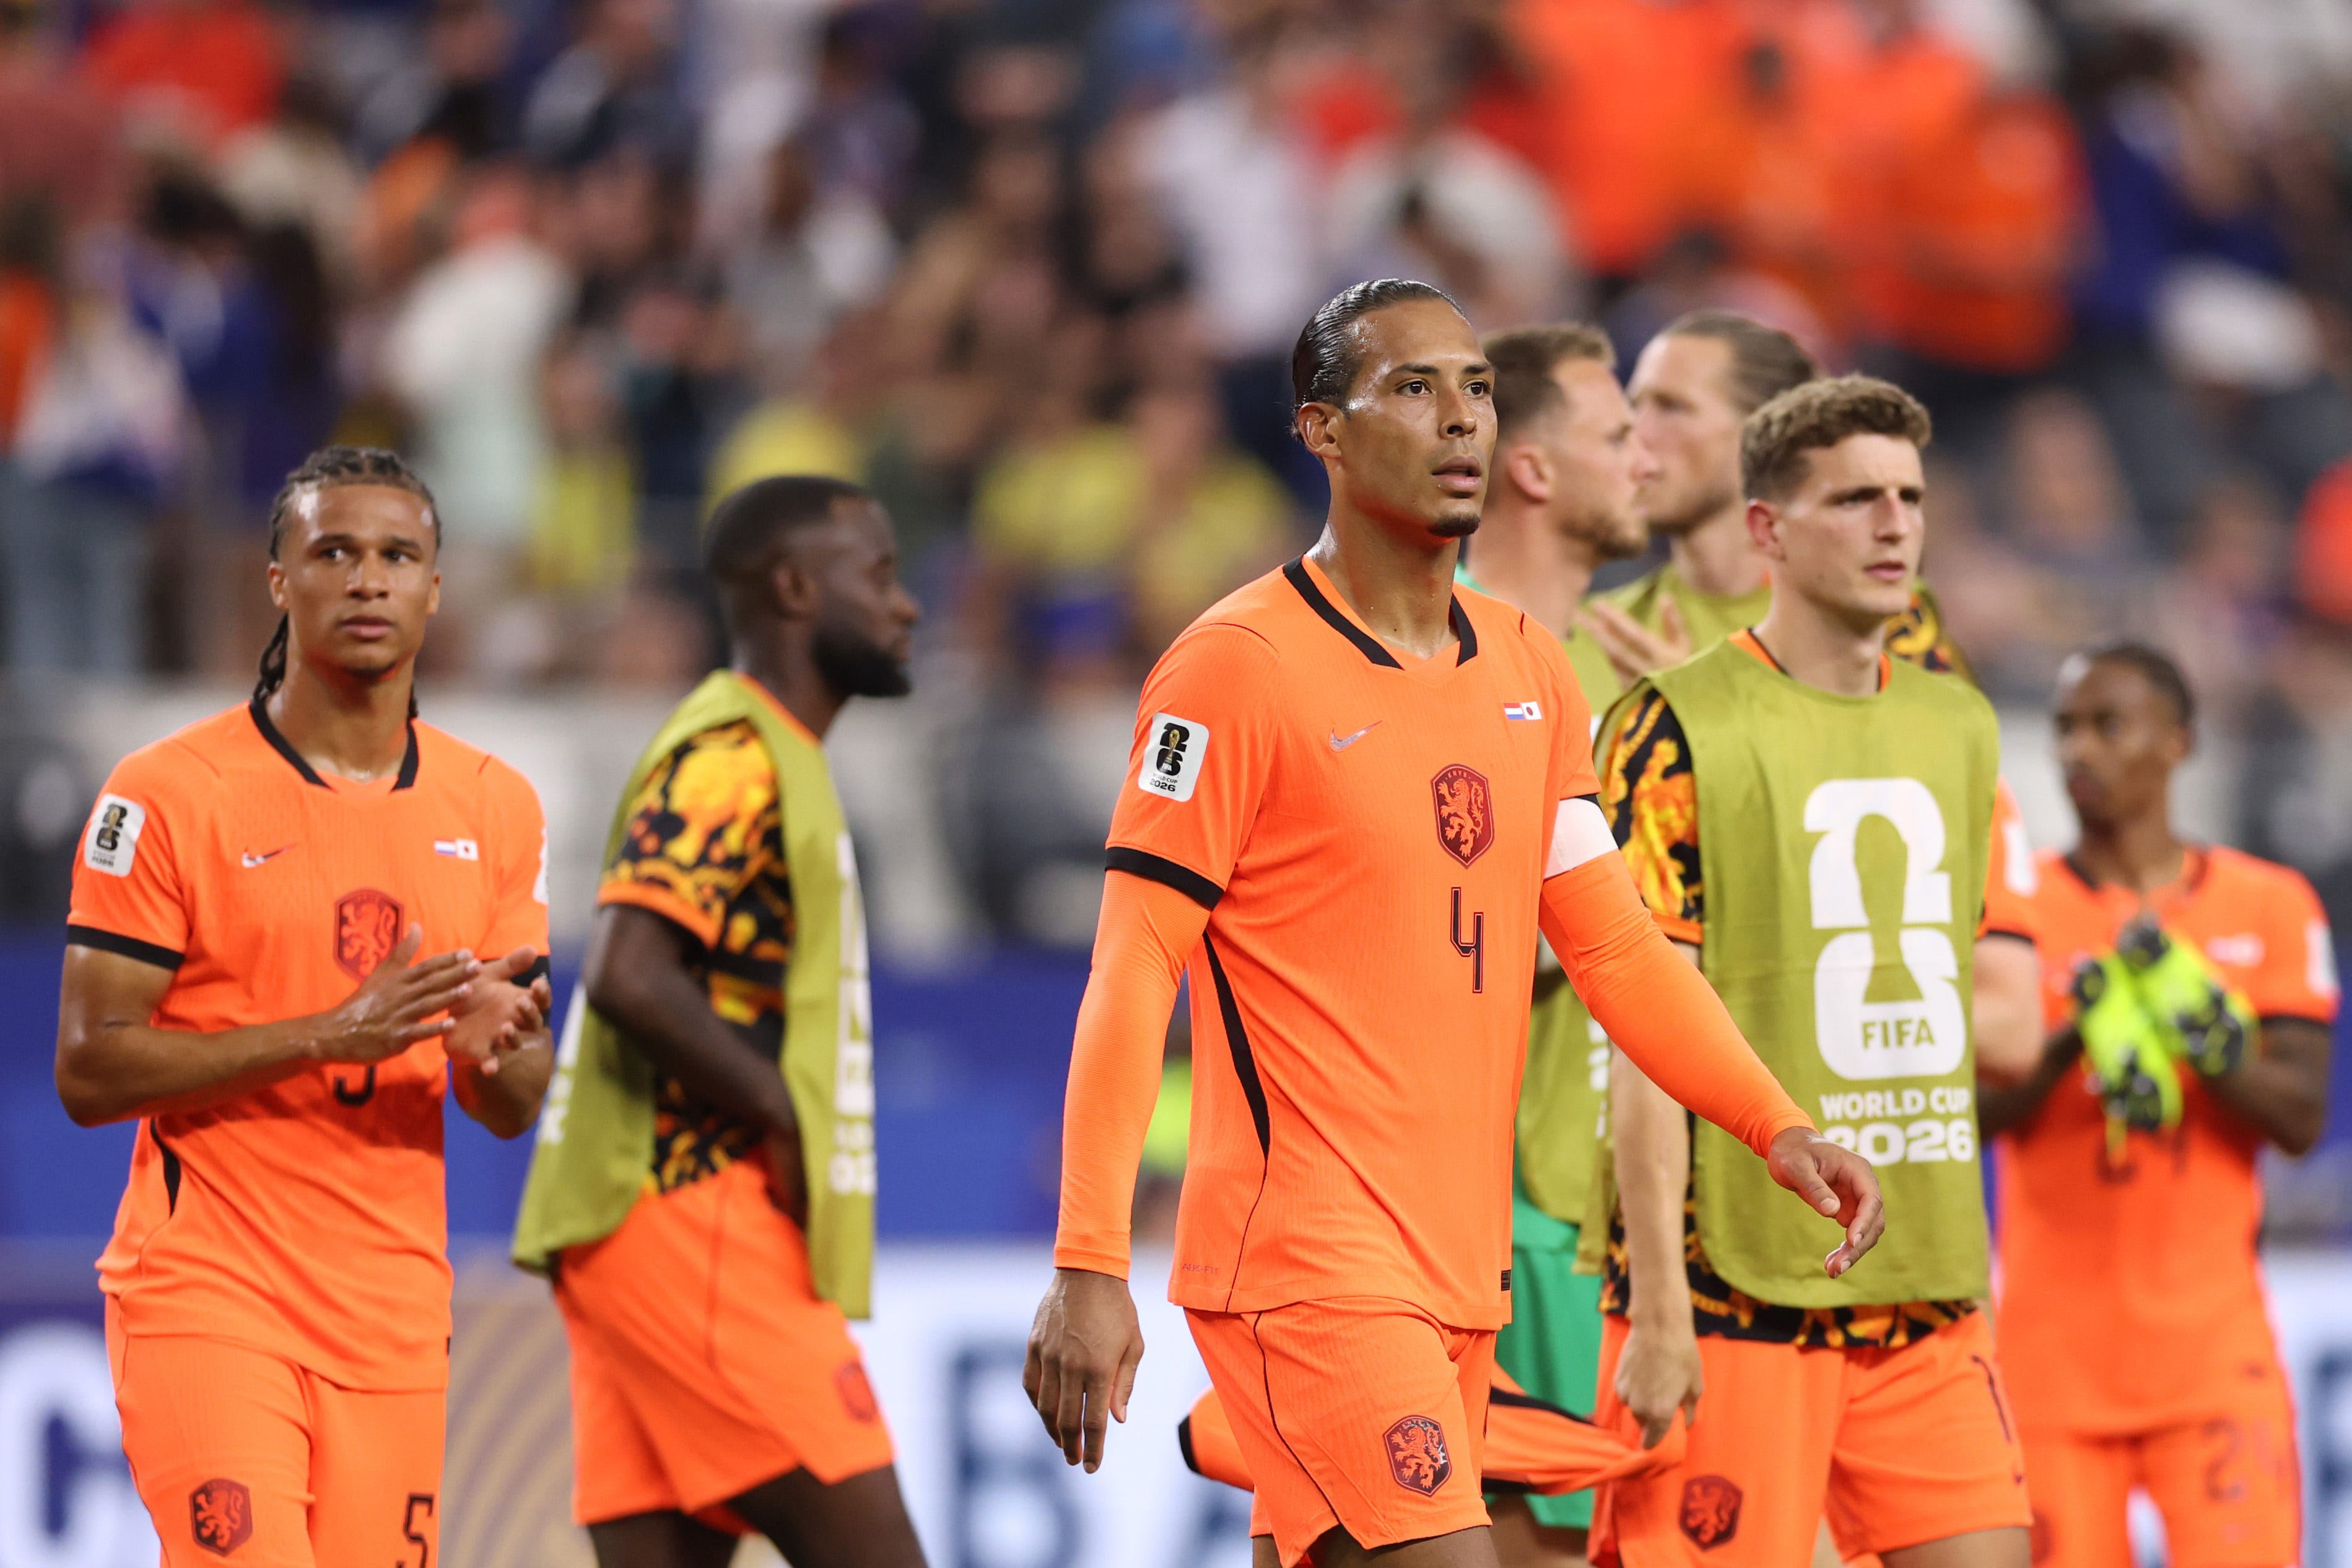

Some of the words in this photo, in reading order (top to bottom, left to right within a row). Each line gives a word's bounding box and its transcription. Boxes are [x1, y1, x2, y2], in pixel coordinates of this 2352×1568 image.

[1149, 778, 1177, 793] 2026
[1450, 887, 1484, 993] 4
[1862, 1017, 1936, 1049] FIFA
[1819, 1088, 1926, 1122] WORLD
[1929, 1086, 1971, 1114] CUP
[395, 1493, 433, 1568] 5
